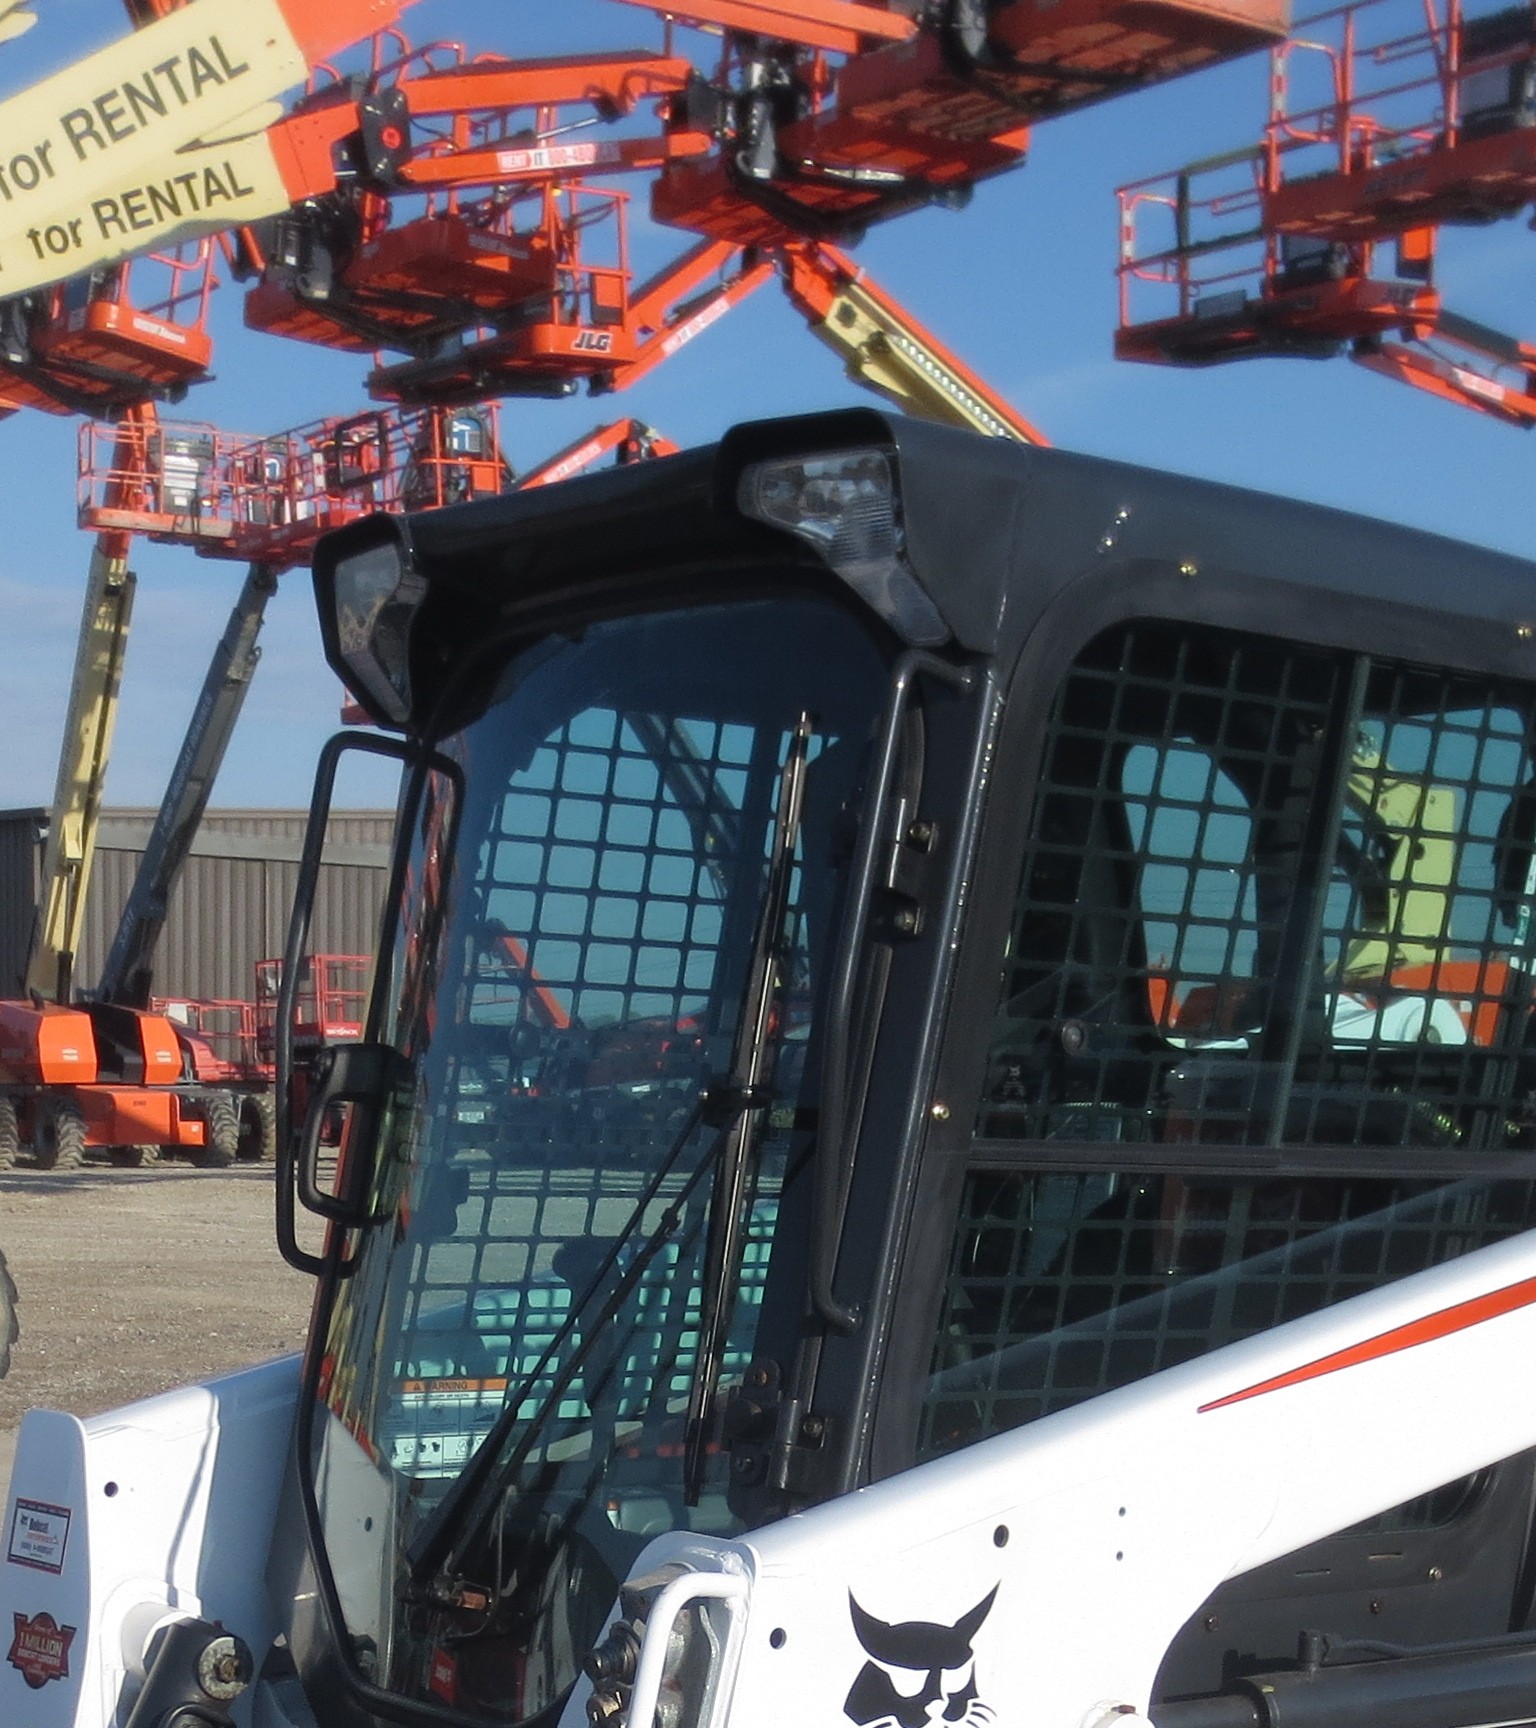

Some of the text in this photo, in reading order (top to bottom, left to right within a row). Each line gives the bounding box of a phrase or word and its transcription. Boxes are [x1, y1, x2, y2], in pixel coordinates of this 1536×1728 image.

[59, 36, 249, 161] RENTAL
[91, 161, 254, 240] RENTAL
[572, 331, 612, 352] JLG
